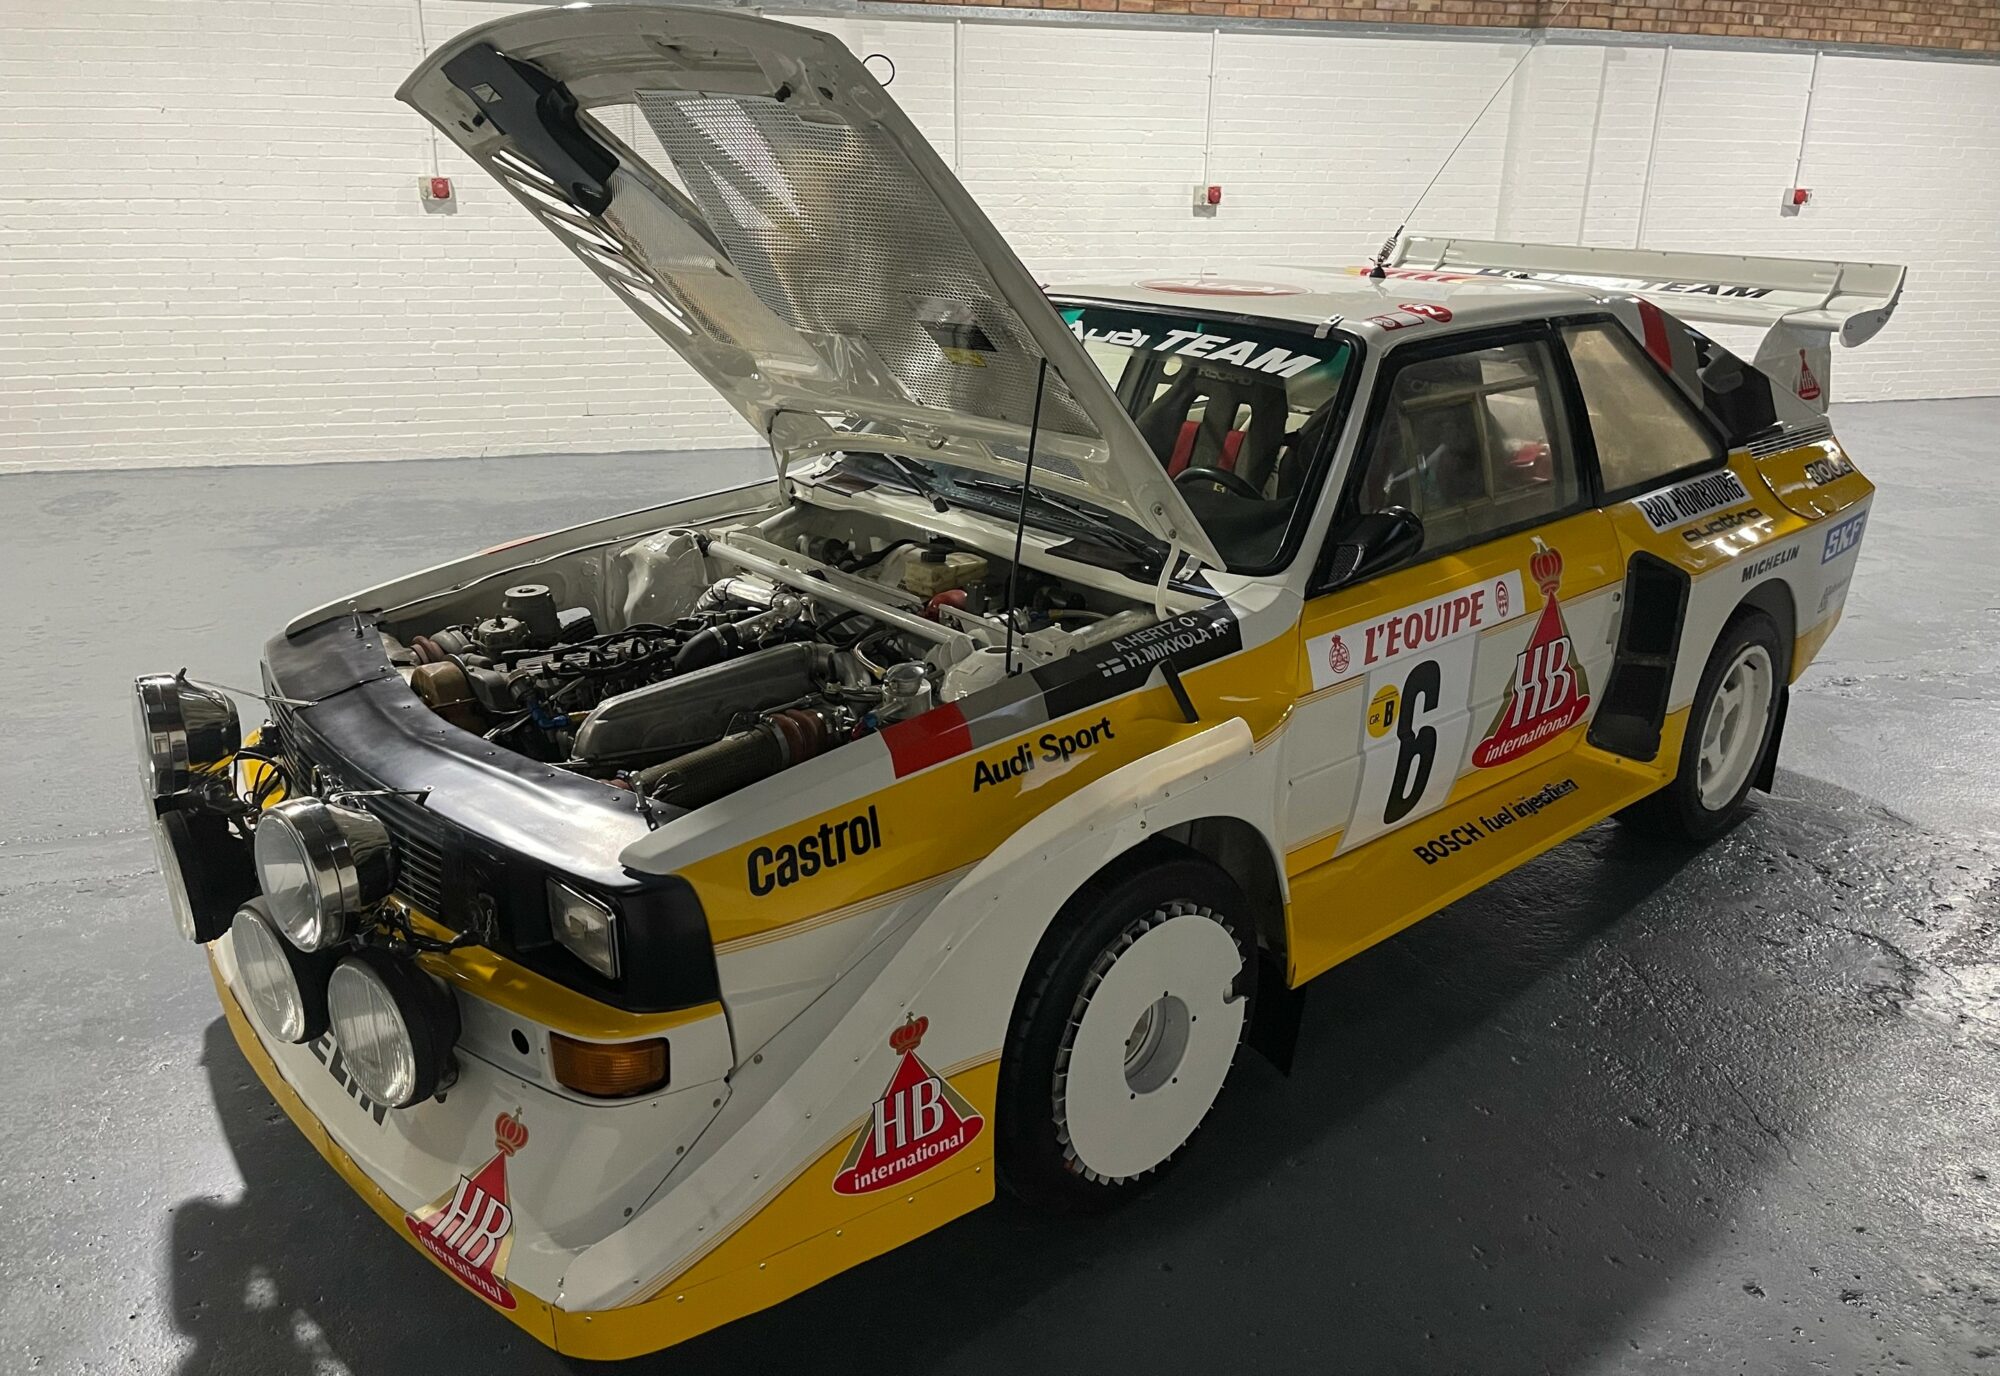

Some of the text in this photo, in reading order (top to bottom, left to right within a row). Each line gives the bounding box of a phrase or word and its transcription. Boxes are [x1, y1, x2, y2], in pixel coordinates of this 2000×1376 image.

[1153, 329, 1321, 378] TEAM
[1638, 472, 1746, 527] BAD HOMBOURG
[1682, 508, 1763, 542] quattro
[1741, 545, 1800, 582] MICHELIN
[1824, 518, 1864, 561] SKF
[1112, 621, 1181, 652] A.HERTZ
[1124, 628, 1212, 667] H.MIKKOLA
[1511, 635, 1571, 729] HB
[1383, 700, 1395, 727] B
[1383, 660, 1441, 825] 6
[1484, 706, 1576, 764] international
[972, 716, 1115, 793] Audi Sport
[747, 804, 882, 897] Castrol
[1412, 777, 1579, 865] BOSCH fuel injection
[872, 1075, 944, 1158] HB
[854, 1126, 965, 1190] international
[430, 1173, 513, 1269] HB
[418, 1229, 503, 1302] international
